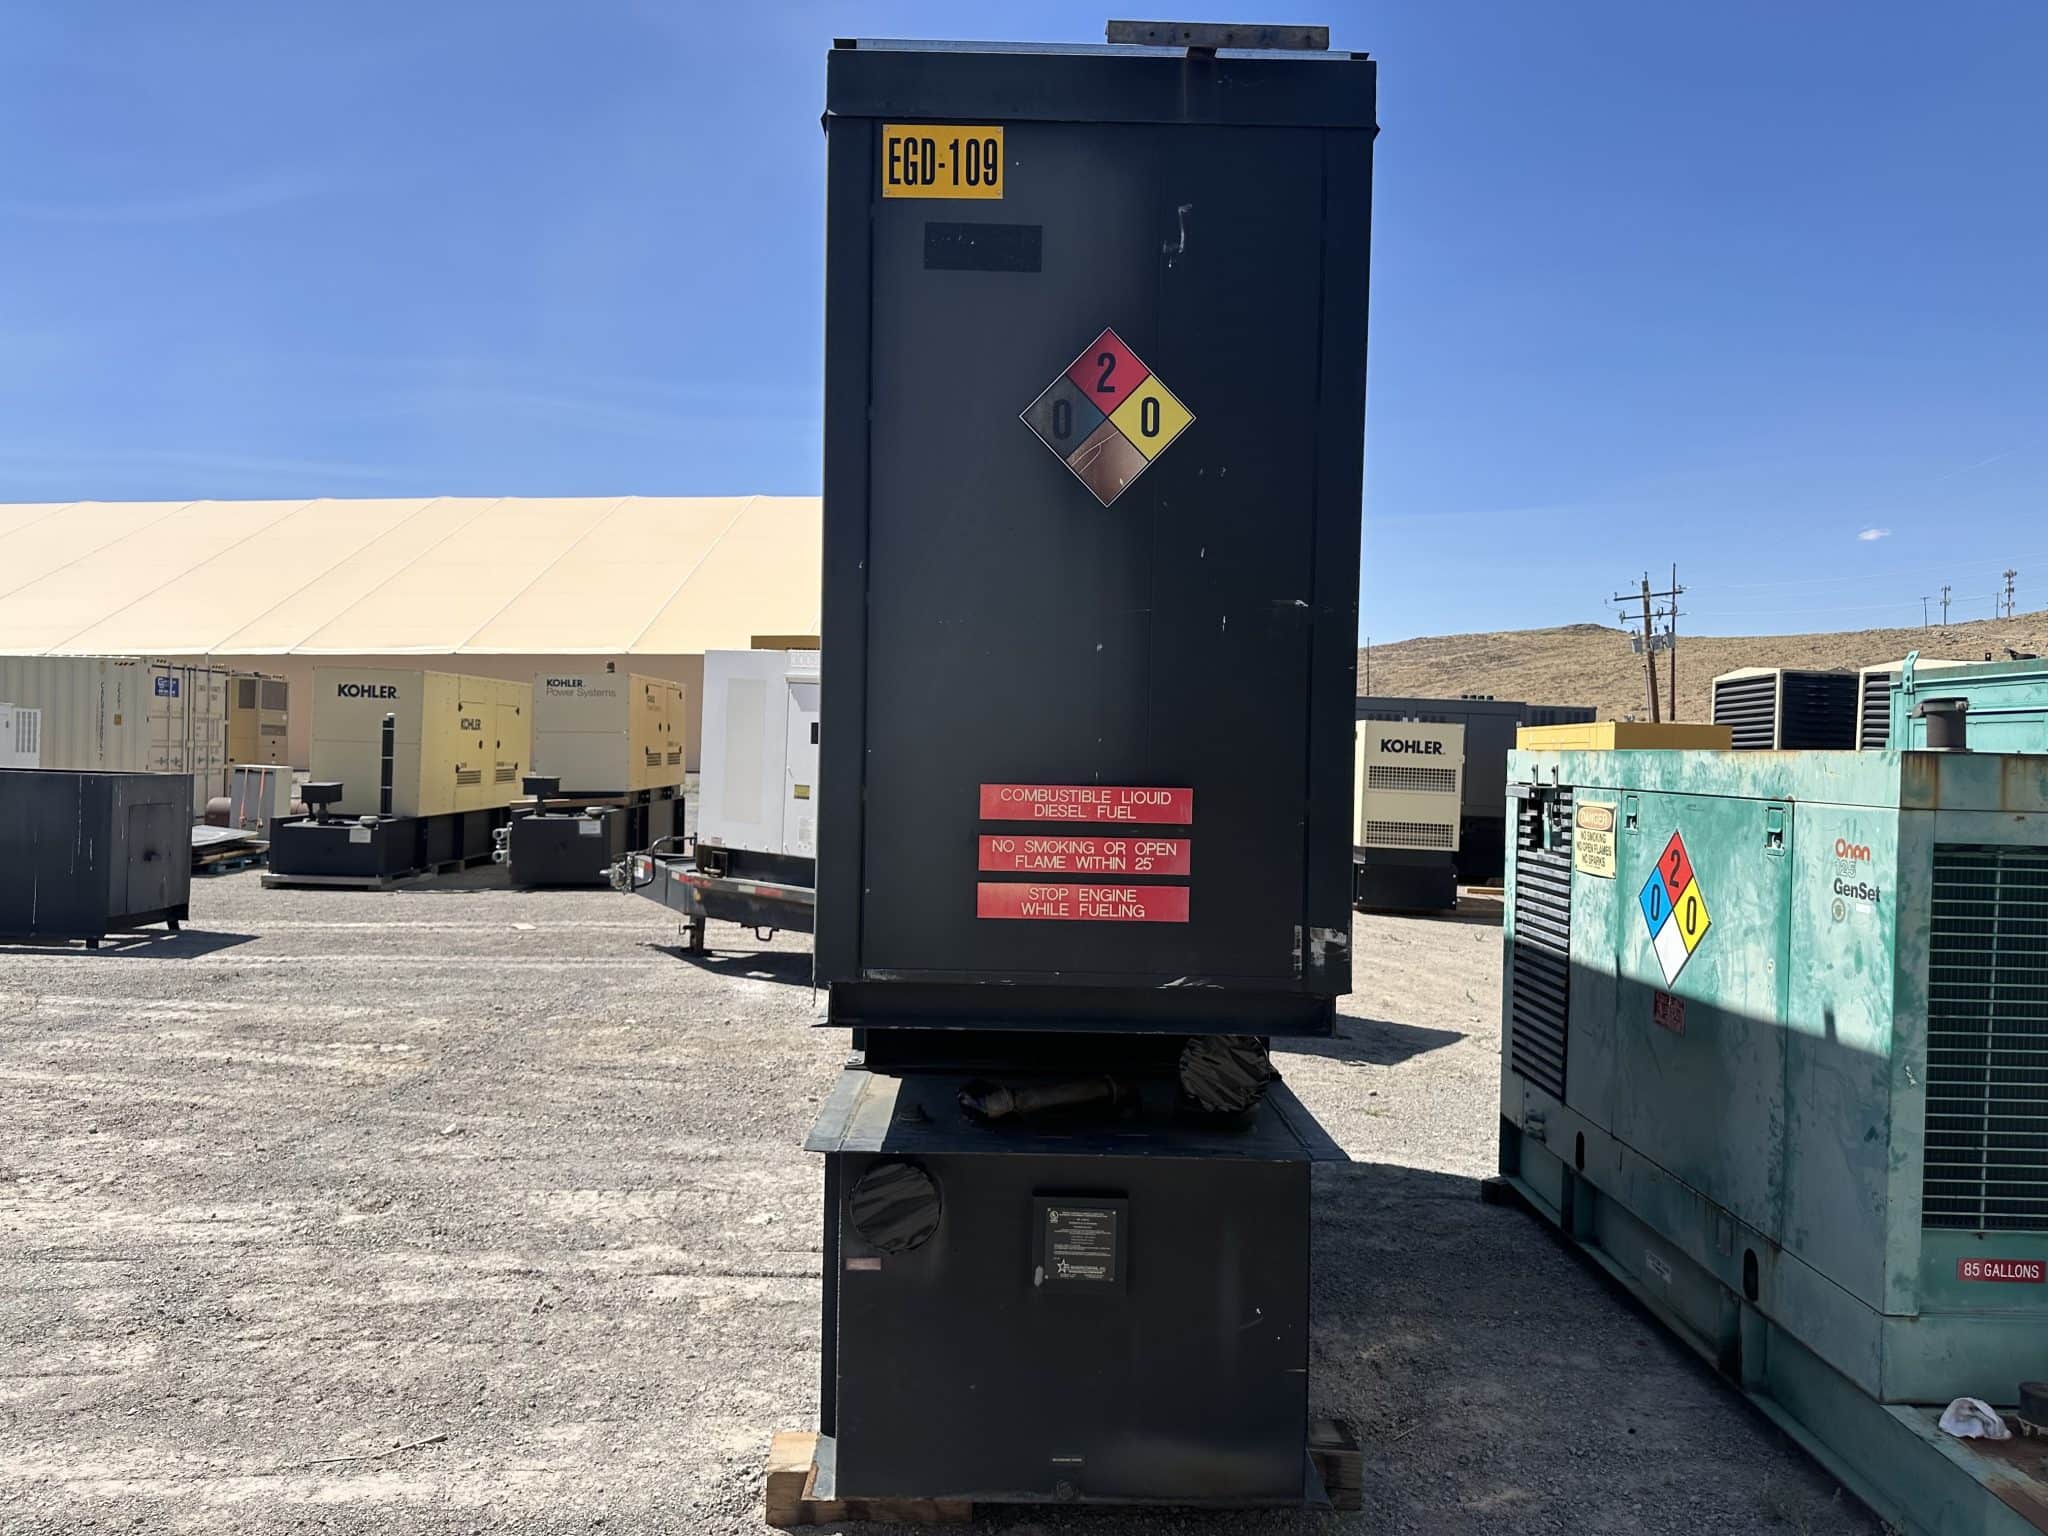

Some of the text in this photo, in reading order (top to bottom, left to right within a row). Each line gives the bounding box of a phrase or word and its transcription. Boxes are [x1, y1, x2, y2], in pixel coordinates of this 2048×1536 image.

[888, 137, 998, 186] EGD-109
[1097, 352, 1116, 393] 2
[1053, 397, 1160, 440] 0 0
[337, 683, 397, 699] KOHLER
[546, 679, 583, 688] KOHLER
[546, 688, 616, 698] Power Systems
[1380, 739, 1442, 755] KOHLER
[1000, 788, 1112, 804] COMBUSTIBLE
[1034, 804, 1137, 819] DIESEL FUEL
[1587, 831, 1607, 844] SMOKING
[992, 839, 1177, 856] NO SMOKING OR OPEN
[1835, 838, 1870, 862] Onan
[1015, 855, 1066, 869] FLAME
[1075, 856, 1126, 870] WITHIN
[1669, 849, 1681, 888] 2
[1028, 888, 1137, 902] STOP ENGINE
[1833, 877, 1880, 903] GenSet
[1021, 903, 1145, 918] WHILE FUELING
[1650, 883, 1697, 935] 0 0
[1963, 1262, 2039, 1279] 85 GALLONS
